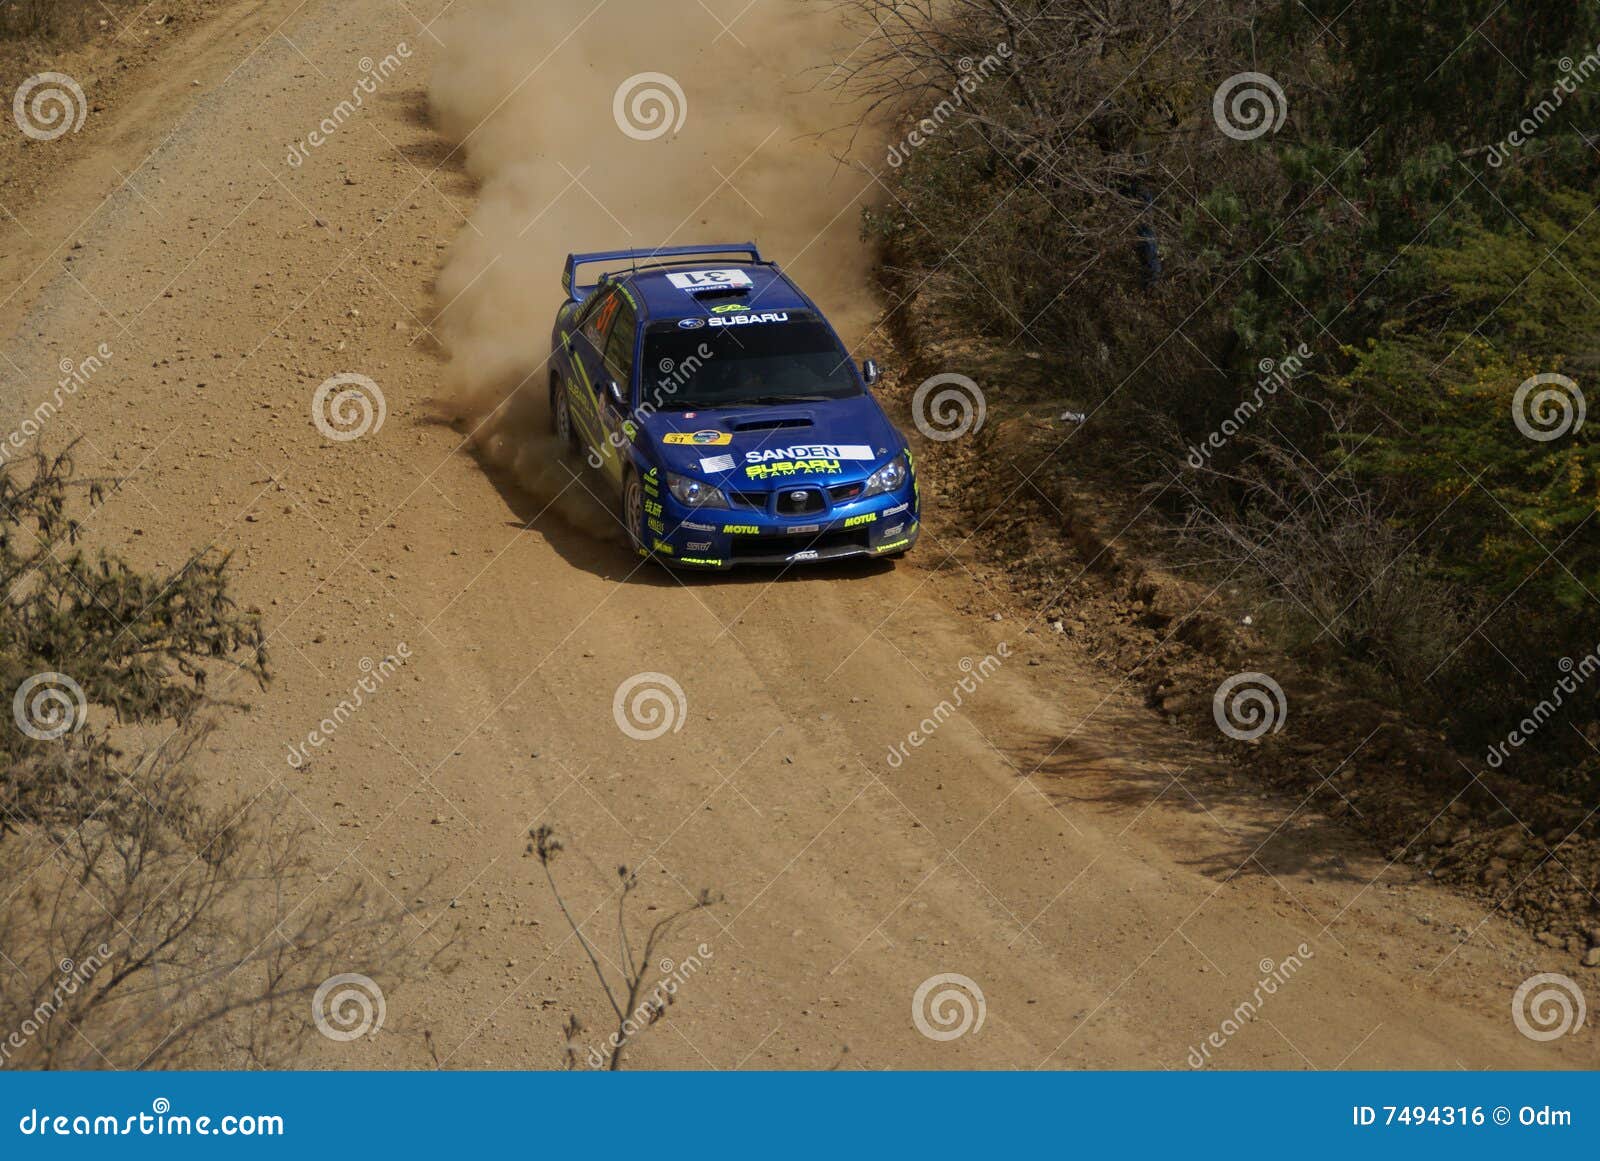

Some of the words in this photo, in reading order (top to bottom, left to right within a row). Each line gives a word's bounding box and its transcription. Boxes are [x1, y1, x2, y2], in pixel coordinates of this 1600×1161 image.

[708, 312, 788, 327] SUBARU
[669, 435, 685, 443] 31
[745, 446, 840, 463] SANDEN
[745, 459, 840, 476] SUBARU
[751, 469, 796, 480] TEAM
[803, 467, 843, 475] ARAI
[845, 513, 877, 527] MOTUL
[723, 525, 760, 534] MOTUL
